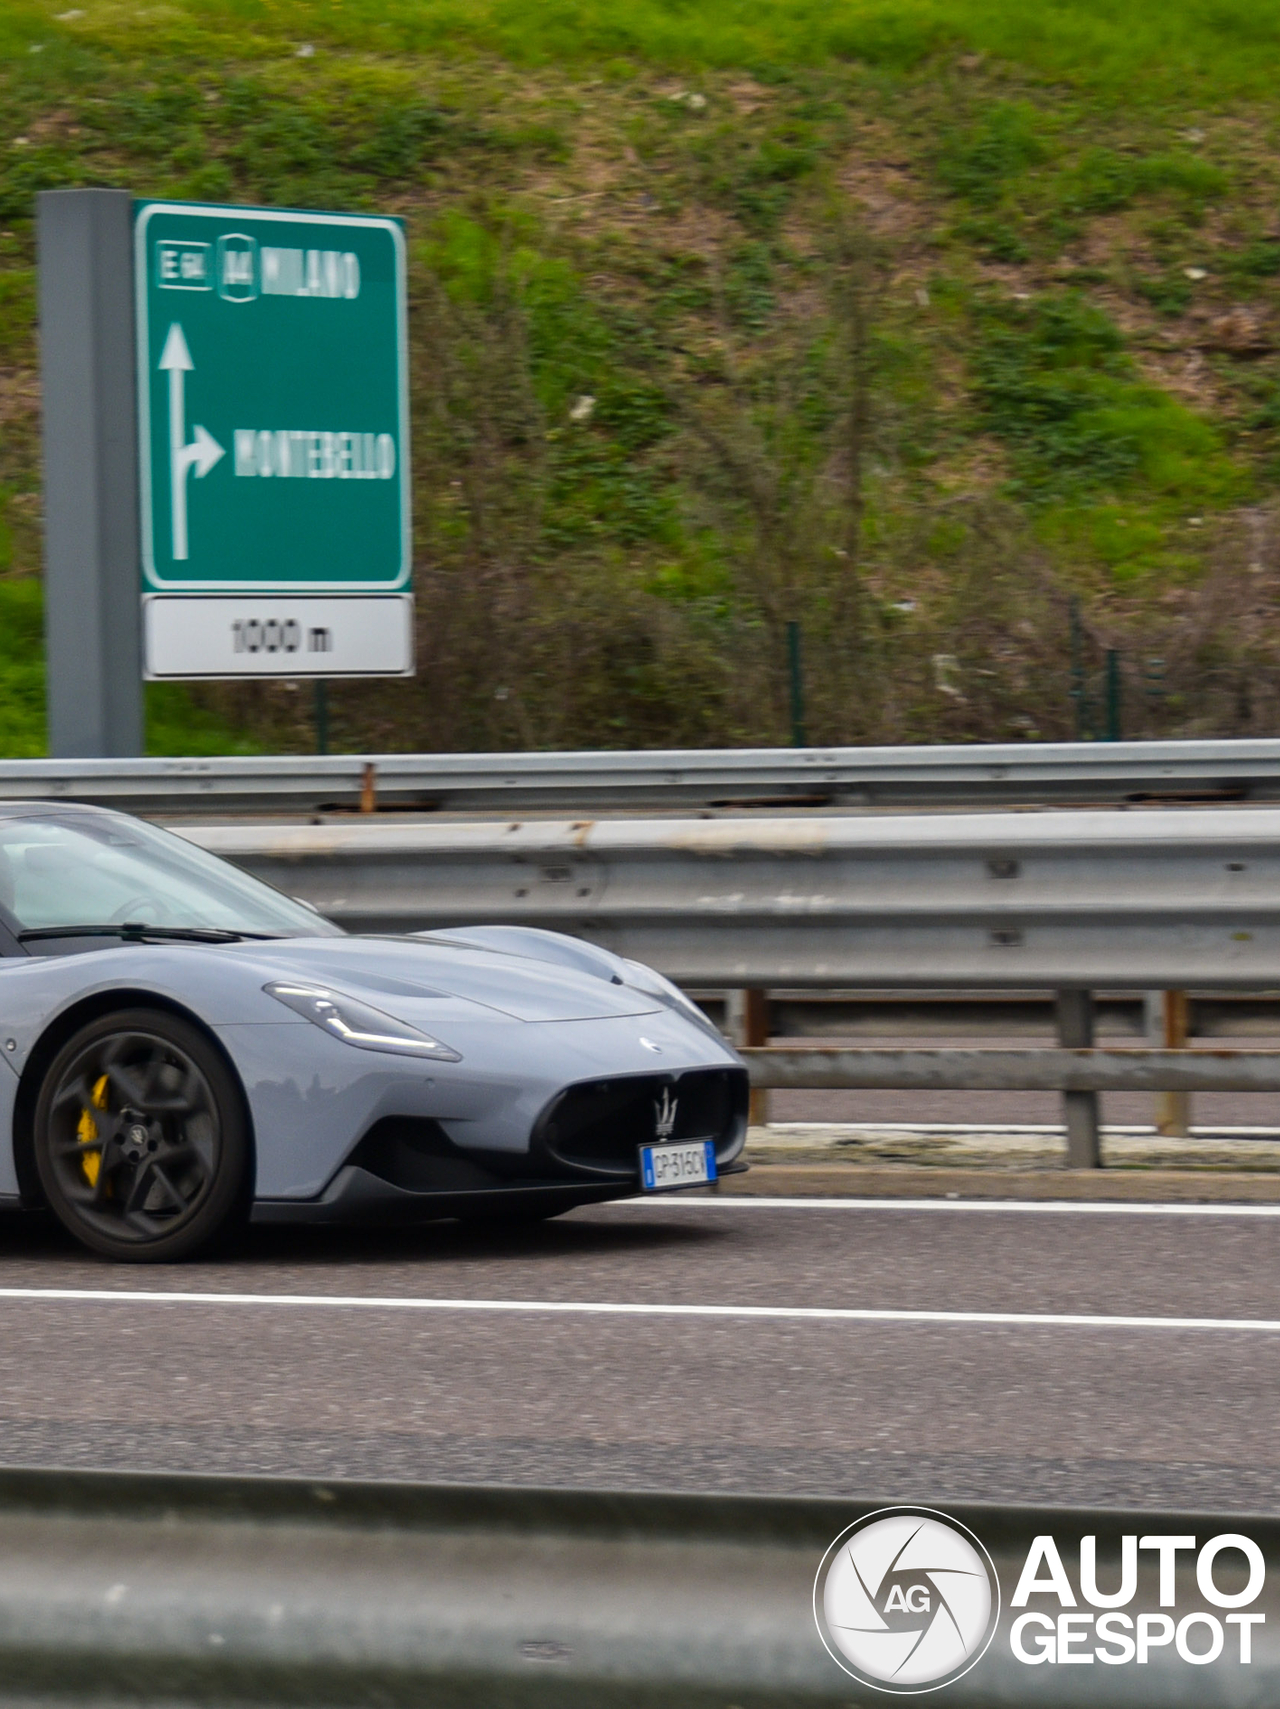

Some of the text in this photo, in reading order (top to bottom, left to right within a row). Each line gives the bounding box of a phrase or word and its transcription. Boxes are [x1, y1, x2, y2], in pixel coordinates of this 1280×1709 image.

[260, 246, 361, 299] MILANO
[233, 429, 396, 480] MONTEBELLO
[231, 618, 333, 653] 1000 m
